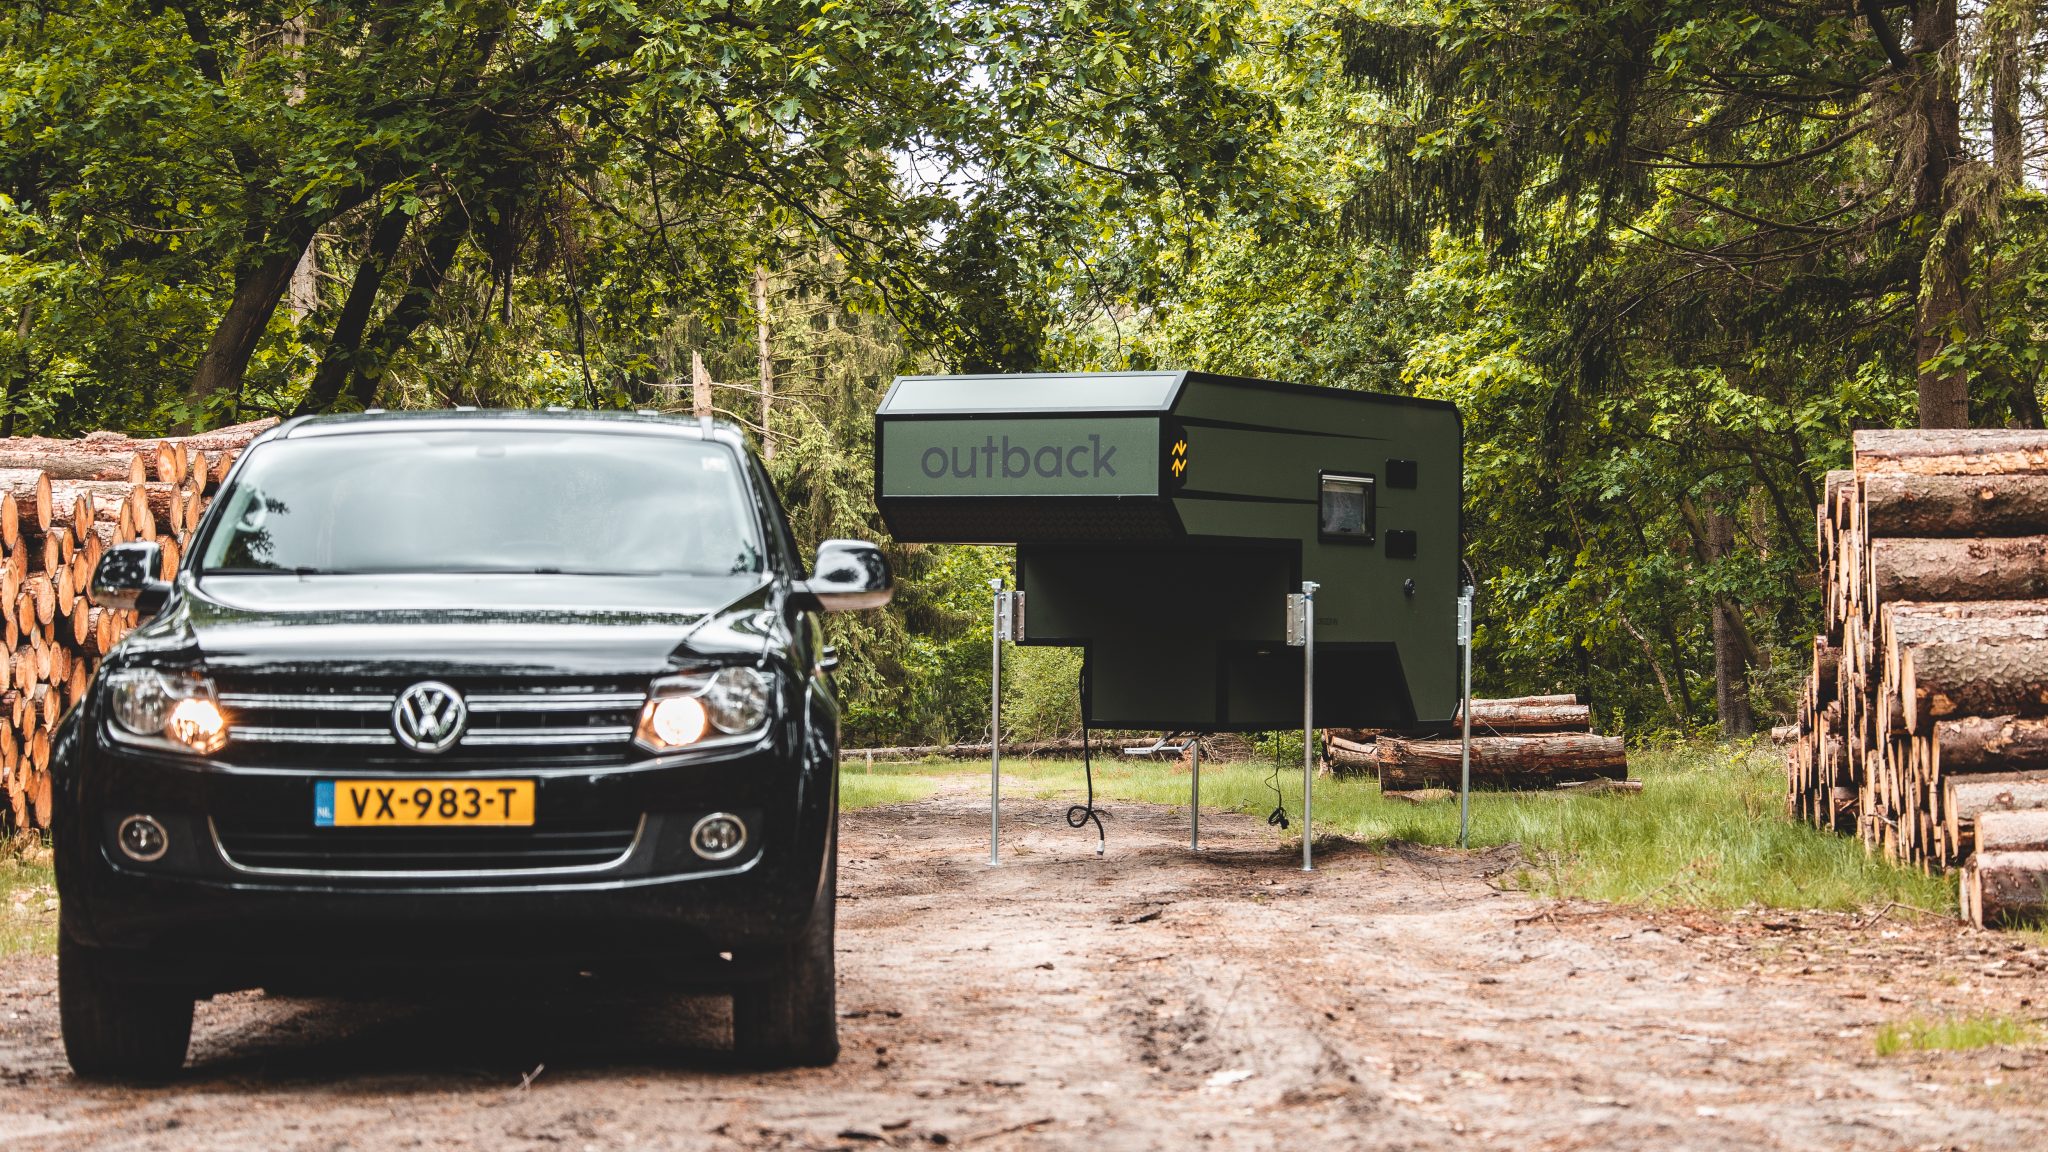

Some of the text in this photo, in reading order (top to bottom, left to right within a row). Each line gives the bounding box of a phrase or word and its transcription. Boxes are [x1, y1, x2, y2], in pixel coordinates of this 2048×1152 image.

[921, 434, 1118, 479] outback
[396, 685, 463, 748] VW
[316, 787, 517, 819] NL VX-983-T
